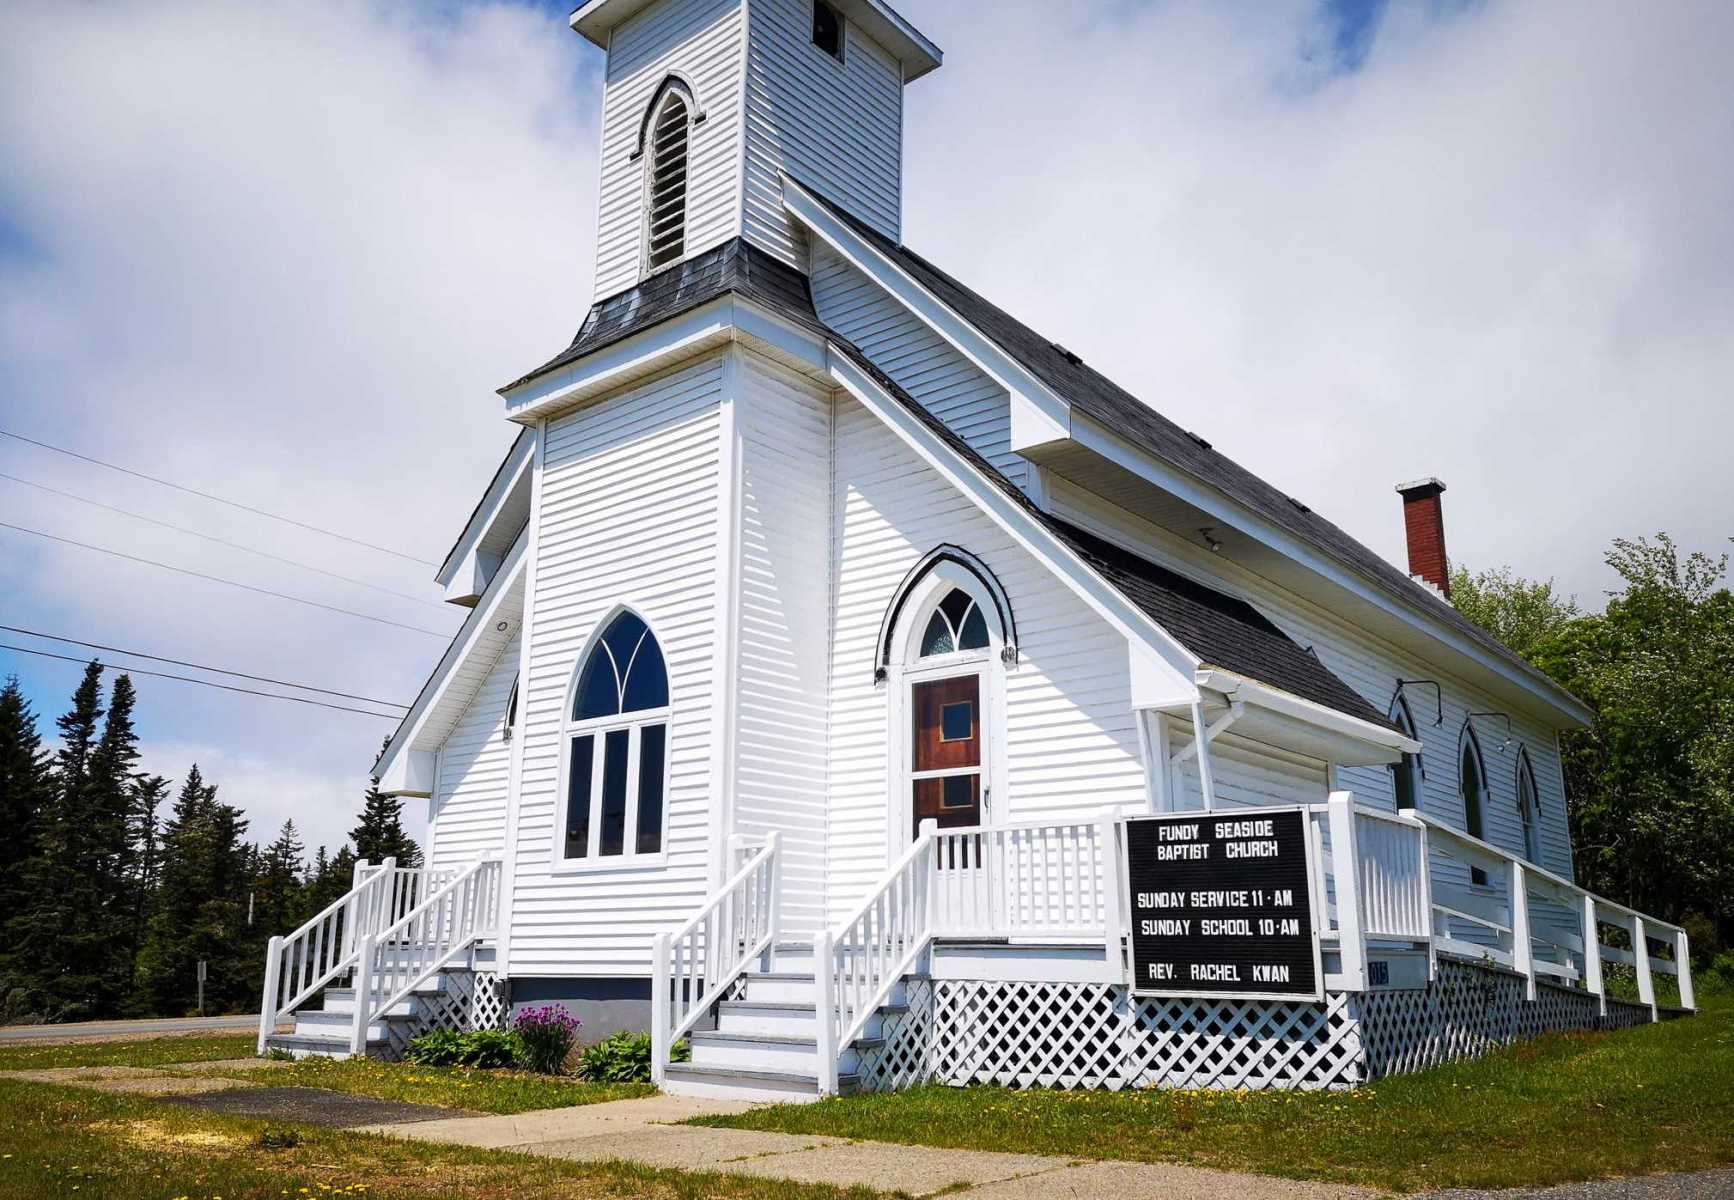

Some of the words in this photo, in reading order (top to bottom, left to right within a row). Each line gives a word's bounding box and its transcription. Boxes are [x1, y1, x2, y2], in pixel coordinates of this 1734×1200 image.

[1159, 824, 1199, 841] FUNDY
[1215, 820, 1274, 839] SEASIDE
[1157, 844, 1210, 861] BAPTIST
[1226, 840, 1279, 858] CHURCH
[1138, 892, 1185, 908] SUNDAY
[1191, 891, 1249, 907] SERVICE
[1141, 919, 1191, 936] SUNDAY
[1201, 919, 1253, 936] SCHOOL
[1149, 963, 1178, 980] REV.
[1191, 963, 1240, 981] RACHEL
[1253, 965, 1289, 982] KWAN
